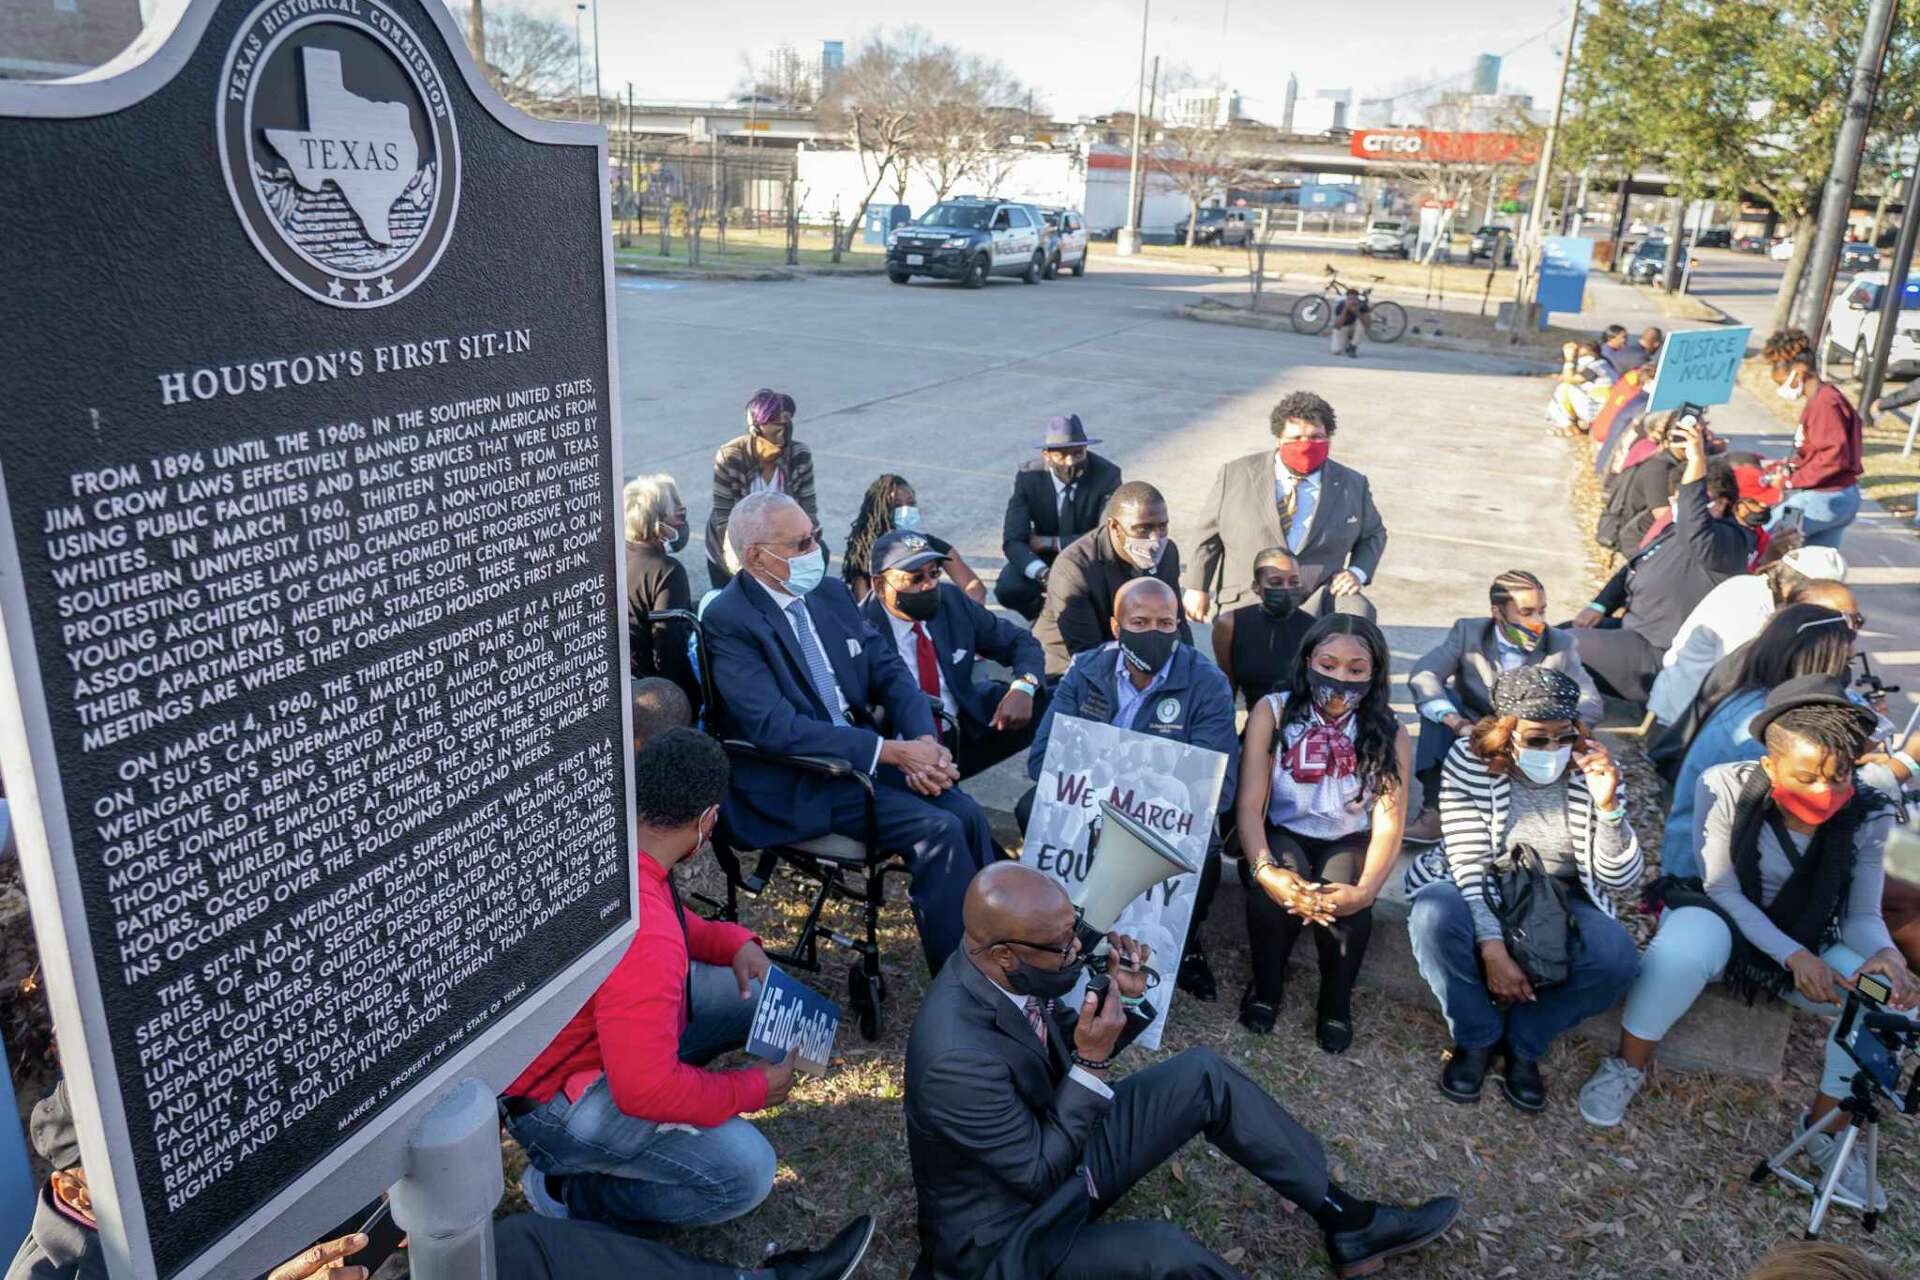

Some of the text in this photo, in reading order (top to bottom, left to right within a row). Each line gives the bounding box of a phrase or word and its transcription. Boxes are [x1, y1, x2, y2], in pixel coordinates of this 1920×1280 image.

[229, 34, 263, 101] TEXAS
[370, 10, 448, 118] COMMISSION
[299, 138, 400, 172] TEXAS
[158, 328, 532, 405] HOUSTON'S FIRST SIT-IN
[1669, 336, 1738, 365] JUSTICE
[47, 415, 597, 560] USING PUBLIC FACILITIES AND BASIC SERVICES THAT WERE USED BY
[70, 464, 140, 496] FROM
[151, 452, 204, 479] 1896
[213, 439, 269, 467] UNTIL
[275, 431, 309, 454] THE
[372, 416, 390, 435] IN
[396, 409, 423, 429] THE
[430, 395, 500, 423] SOUTHERN
[506, 386, 550, 408] UNITED
[57, 567, 181, 616] SOUTHERN
[191, 534, 298, 579] UNIVERSITY
[357, 502, 418, 533] STARTED
[425, 498, 436, 514] A
[441, 471, 530, 509] NON-VIOLENT
[536, 453, 599, 483] MOVEMENT
[66, 490, 601, 670] YOUNG ARCHITECTS OF CHANGE FORMED THE PROGRESSIVE YOUTH
[82, 695, 193, 751] MEETINGS
[199, 678, 237, 708] ARE
[241, 653, 305, 690] WHERE
[309, 637, 349, 665] THEY
[355, 604, 442, 647] ORGANIZED
[523, 562, 552, 585] FIRST
[118, 751, 157, 780] ON
[164, 720, 236, 763] MARCH
[321, 674, 351, 699] THE
[356, 646, 423, 684] THIRTEEN
[428, 618, 492, 656] STUDENTS
[496, 607, 519, 629] MET
[523, 599, 537, 618] AT
[540, 596, 549, 611] A
[552, 573, 604, 605] FLAGPOLE
[271, 704, 385, 766] SUPERMARKET
[446, 656, 498, 690] ALMEDA
[506, 635, 544, 663] ROAD)
[551, 619, 580, 642] WITH
[586, 608, 606, 627] THE
[108, 848, 170, 892] MORE
[177, 813, 247, 859] JOINED
[252, 788, 300, 821] THEM
[306, 775, 327, 798] AS
[331, 753, 369, 783] THEY
[451, 690, 506, 726] SINGING
[510, 671, 545, 699] BLACK
[115, 879, 209, 939] PATRONS
[217, 841, 285, 887] HURLED
[293, 804, 356, 848] INSULTS
[363, 790, 381, 813] AT
[435, 747, 467, 774] THEY
[473, 732, 494, 755] SAT
[499, 713, 534, 741] THERE
[539, 687, 584, 721] SILENTLY
[588, 676, 609, 696] FOR
[1109, 786, 1194, 836] MARCH
[123, 952, 161, 985] INS
[166, 895, 269, 960] OCCURRED
[274, 867, 320, 901] OVER
[323, 848, 352, 874] THE
[357, 800, 442, 857] FOLLOWING
[446, 780, 478, 808] DAYS
[482, 764, 509, 789] AND
[135, 751, 612, 1044] SERIES OF NON-VIOLENT DEMONSTRATIONS LEADING TO THE
[143, 1035, 211, 1088] LUNCH
[220, 972, 312, 1038] COUNTERS
[319, 929, 379, 976] QUIETLY
[386, 864, 485, 935] DESEGREGATED
[490, 847, 511, 869] ON
[516, 816, 560, 854] AUGUST
[153, 1091, 197, 1131] AND
[313, 952, 404, 1024] ASTRODOME
[409, 916, 462, 958] OPENED
[466, 902, 480, 922] IN
[485, 881, 513, 908] 1965
[517, 869, 532, 889] AS
[535, 855, 552, 877] AN
[555, 816, 615, 862] INTEGRATED
[159, 1112, 231, 1171] RIGHTS
[365, 987, 409, 1027] THESE
[418, 938, 480, 989] THIRTEEN
[488, 897, 541, 941] UNSUNG
[548, 863, 591, 900] HEROES
[597, 845, 617, 868] ARE
[167, 1154, 233, 1212] RIGHTS
[239, 1123, 277, 1161] AND
[282, 1064, 355, 1128] EQUALITY
[359, 1049, 376, 1071] IN
[337, 981, 525, 1131] MARKER IS PROPERTY OF THE STATE OF TEXAS
